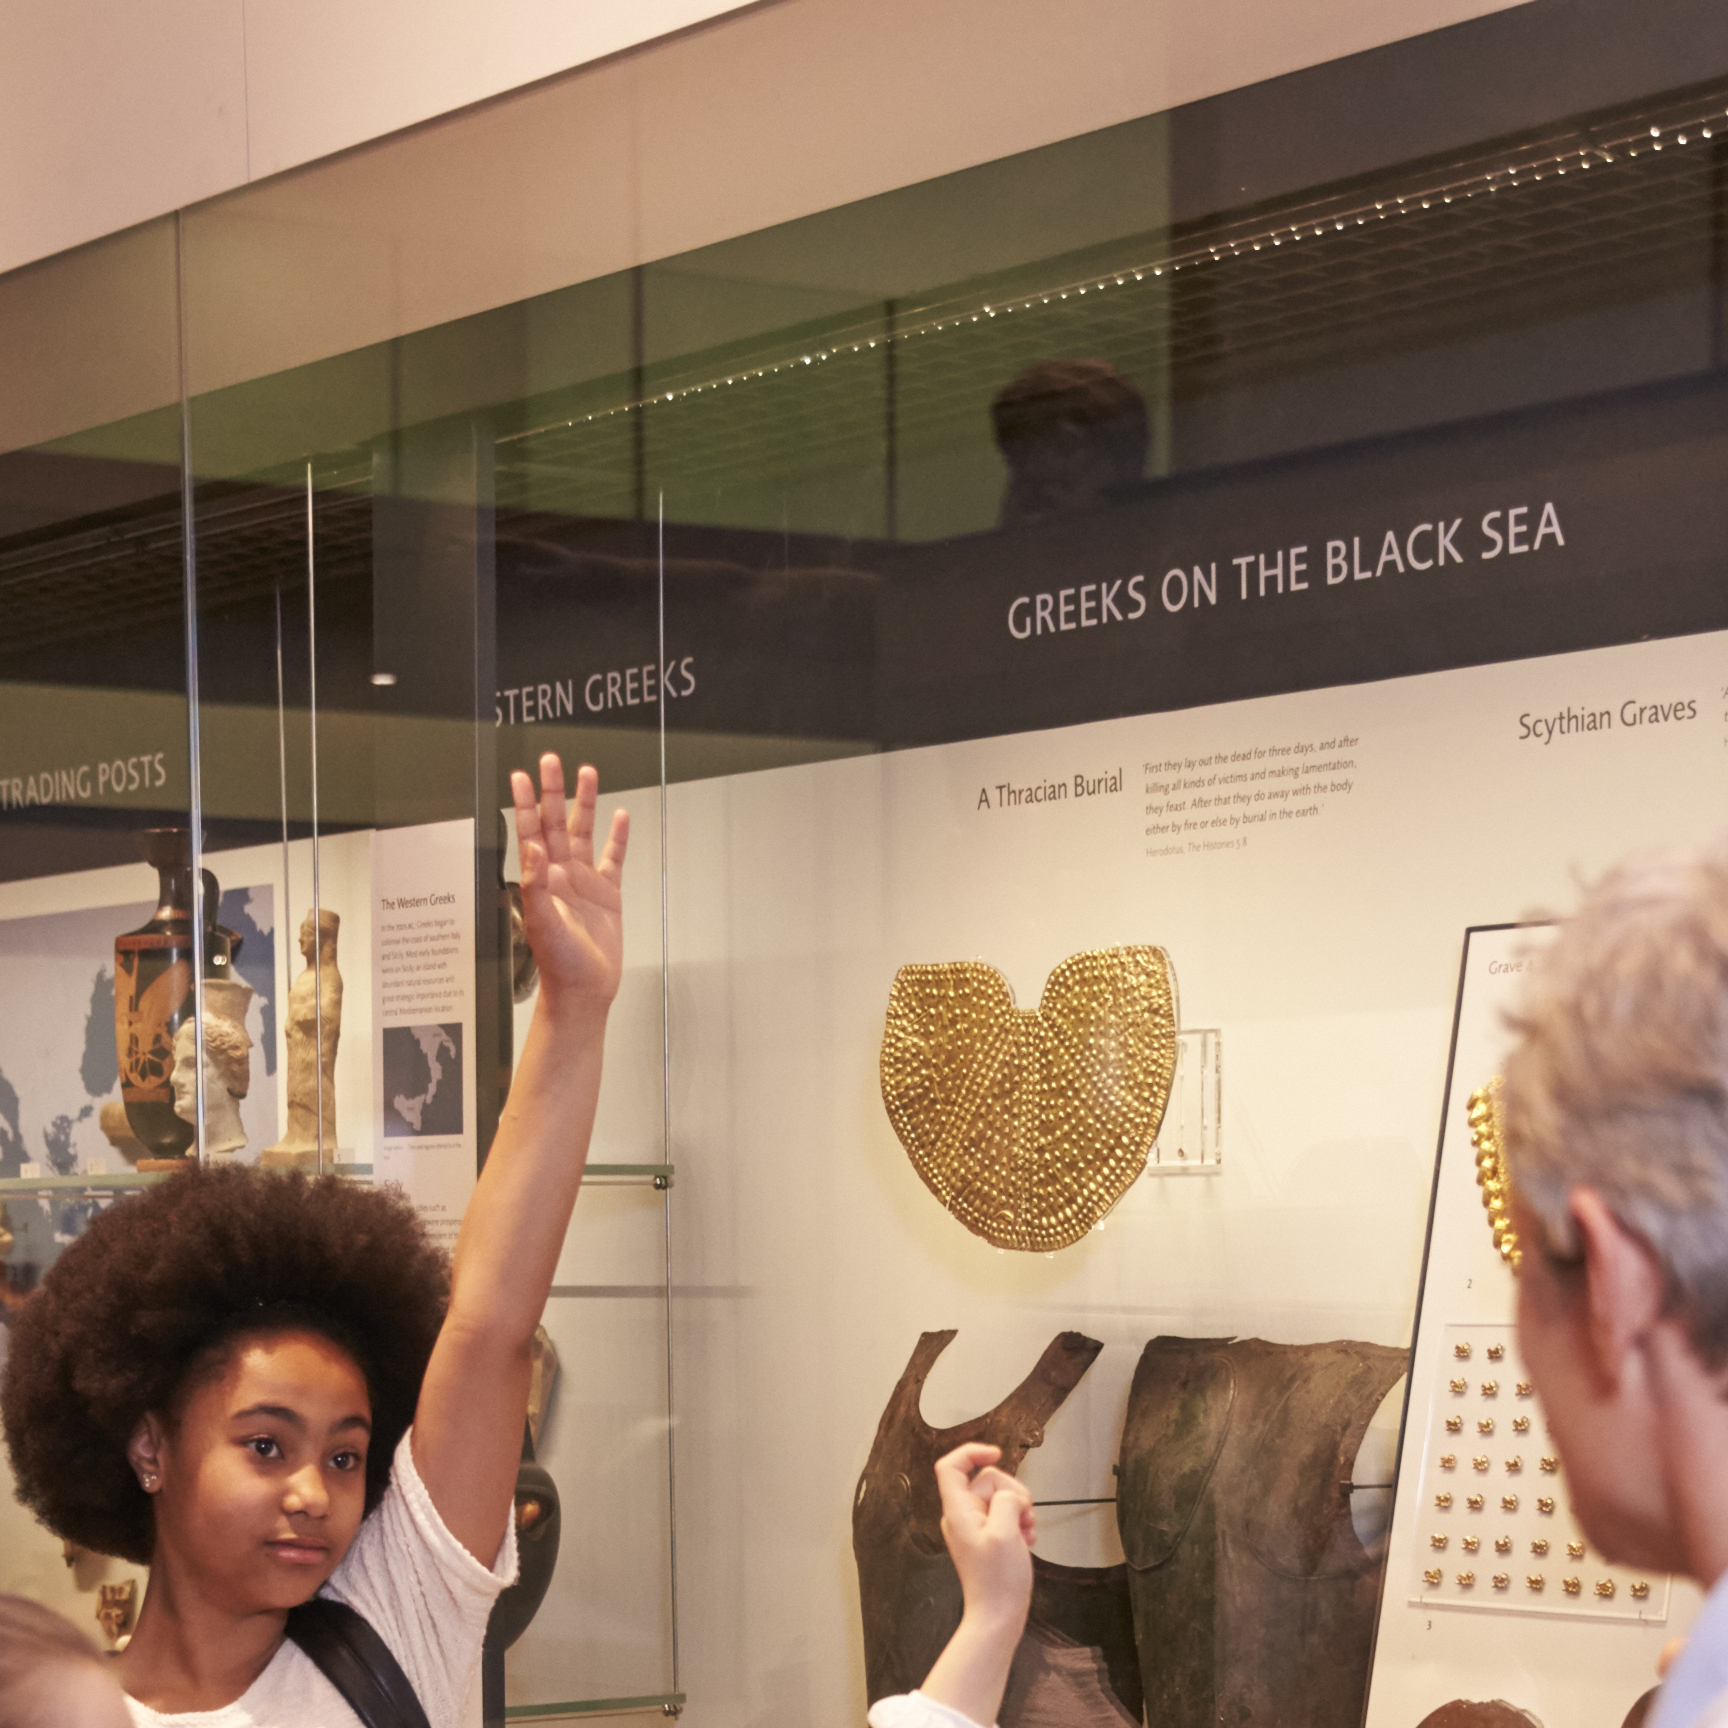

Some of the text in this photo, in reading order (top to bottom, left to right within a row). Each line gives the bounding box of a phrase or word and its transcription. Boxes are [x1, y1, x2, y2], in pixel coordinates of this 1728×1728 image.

[1008, 501, 1565, 639] GREEKS ON THE BLACK SEA
[585, 657, 696, 712] GREEKS
[1519, 699, 1697, 746] Scythian Graves
[98, 751, 166, 795] POSTS
[1164, 760, 1183, 773] they
[1184, 757, 1197, 771] lay
[1198, 755, 1213, 767] out
[1214, 753, 1229, 765] the
[1230, 749, 1252, 763] dead
[1254, 747, 1267, 759] for
[1268, 745, 1292, 757] three
[1318, 737, 1336, 751] and
[1337, 735, 1359, 749] after
[977, 767, 1123, 811] A Thracian Burial
[1145, 803, 1164, 817] they
[1190, 796, 1212, 809] After
[1214, 795, 1231, 807] that
[1232, 792, 1252, 806] they
[1253, 789, 1266, 802] do
[1267, 789, 1290, 802] away
[1292, 783, 1311, 797] with
[1313, 782, 1328, 794] the
[1330, 778, 1353, 794] body
[1171, 779, 1182, 792] all
[1183, 776, 1205, 789] kinds
[1207, 773, 1217, 787] of
[1218, 773, 1248, 785] victims
[1249, 768, 1267, 781] and
[1268, 765, 1300, 780] making
[1145, 823, 1170, 836] either
[1169, 821, 1182, 835] by
[1181, 819, 1197, 831] fire
[1197, 820, 1209, 830] or
[1208, 816, 1228, 828] else
[1227, 814, 1240, 829] by
[1239, 812, 1265, 824] burial
[1264, 810, 1276, 822] in
[1276, 808, 1292, 820] the
[381, 892, 456, 910] The Western Greeks
[1489, 961, 1522, 975] Grave
[1467, 1278, 1472, 1289] 2
